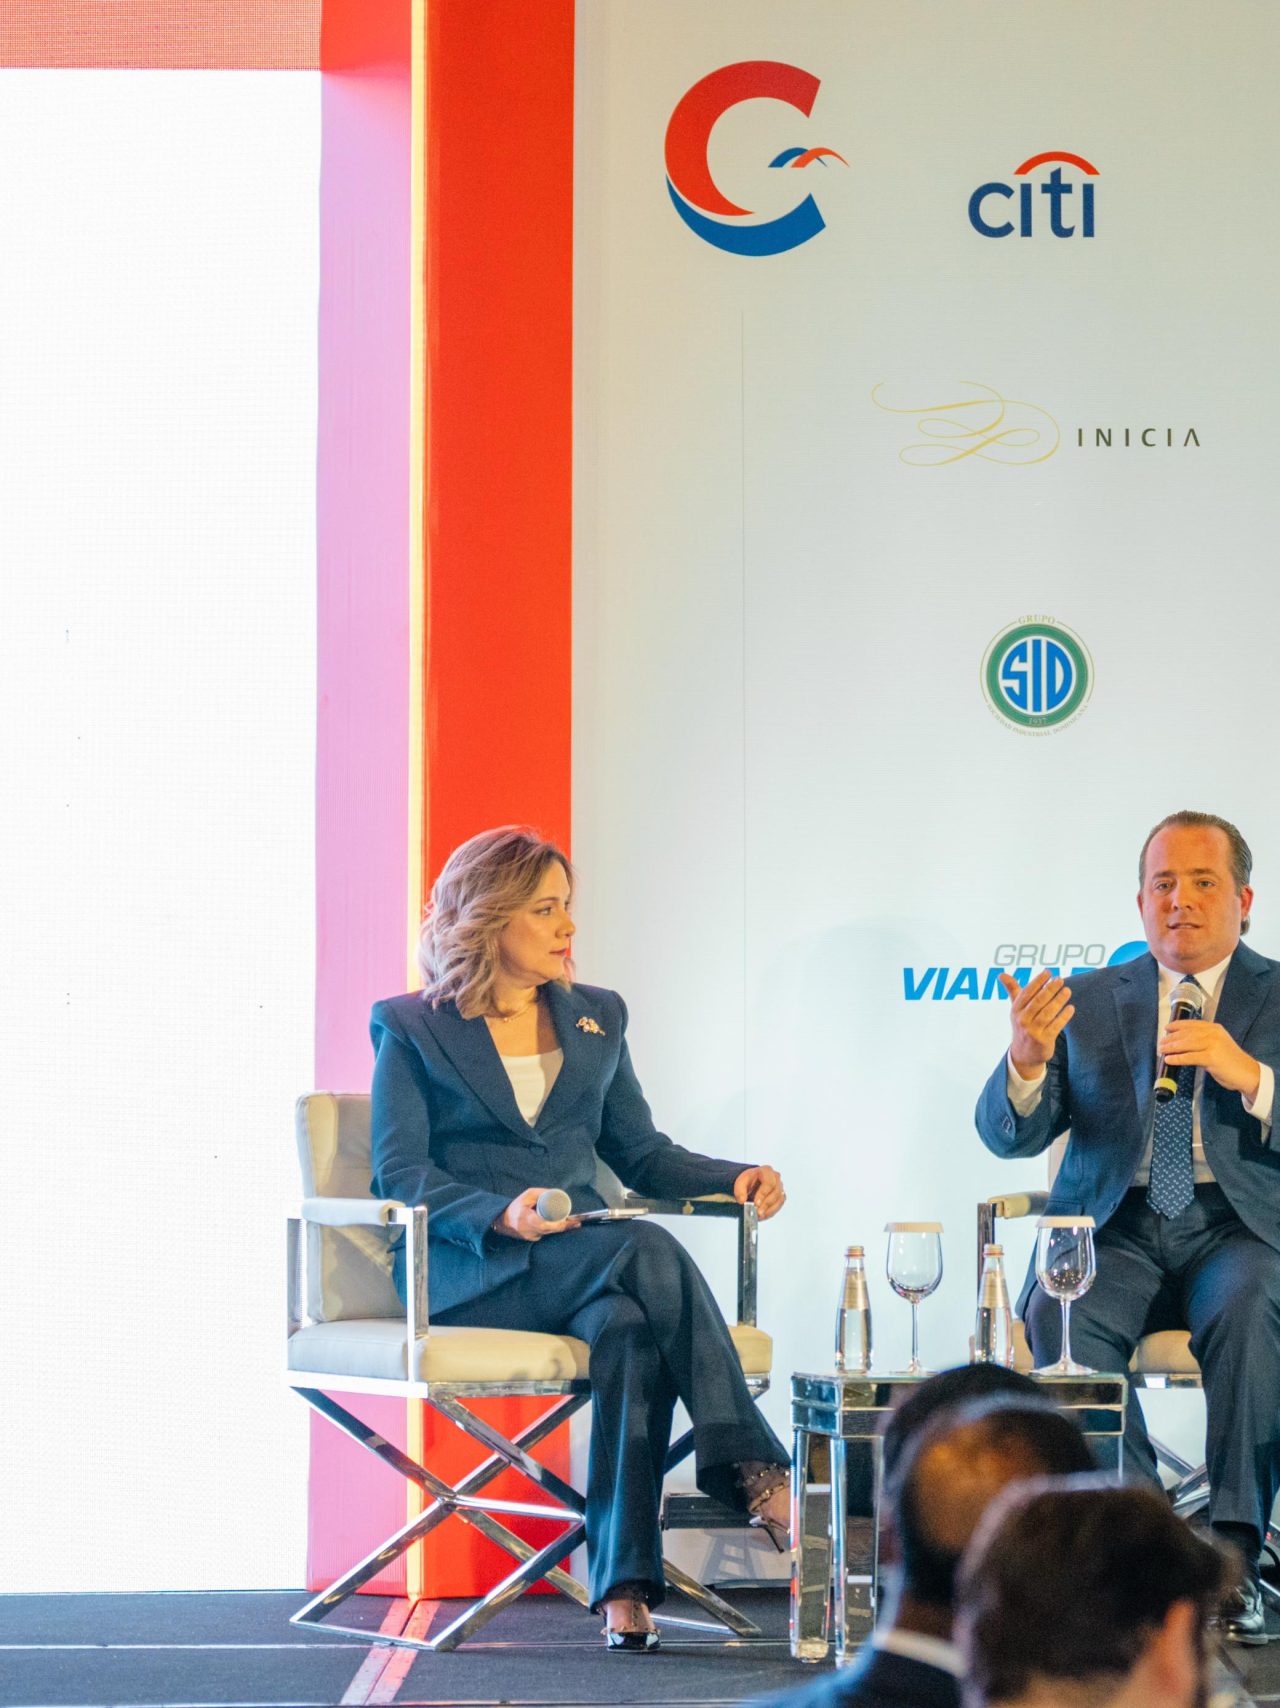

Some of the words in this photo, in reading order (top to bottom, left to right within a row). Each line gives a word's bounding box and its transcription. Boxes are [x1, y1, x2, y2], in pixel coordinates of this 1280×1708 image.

[967, 167, 1096, 238] citi
[1077, 427, 1201, 448] INICIA
[1001, 638, 1073, 713] SID
[993, 943, 1106, 967] GRUPO
